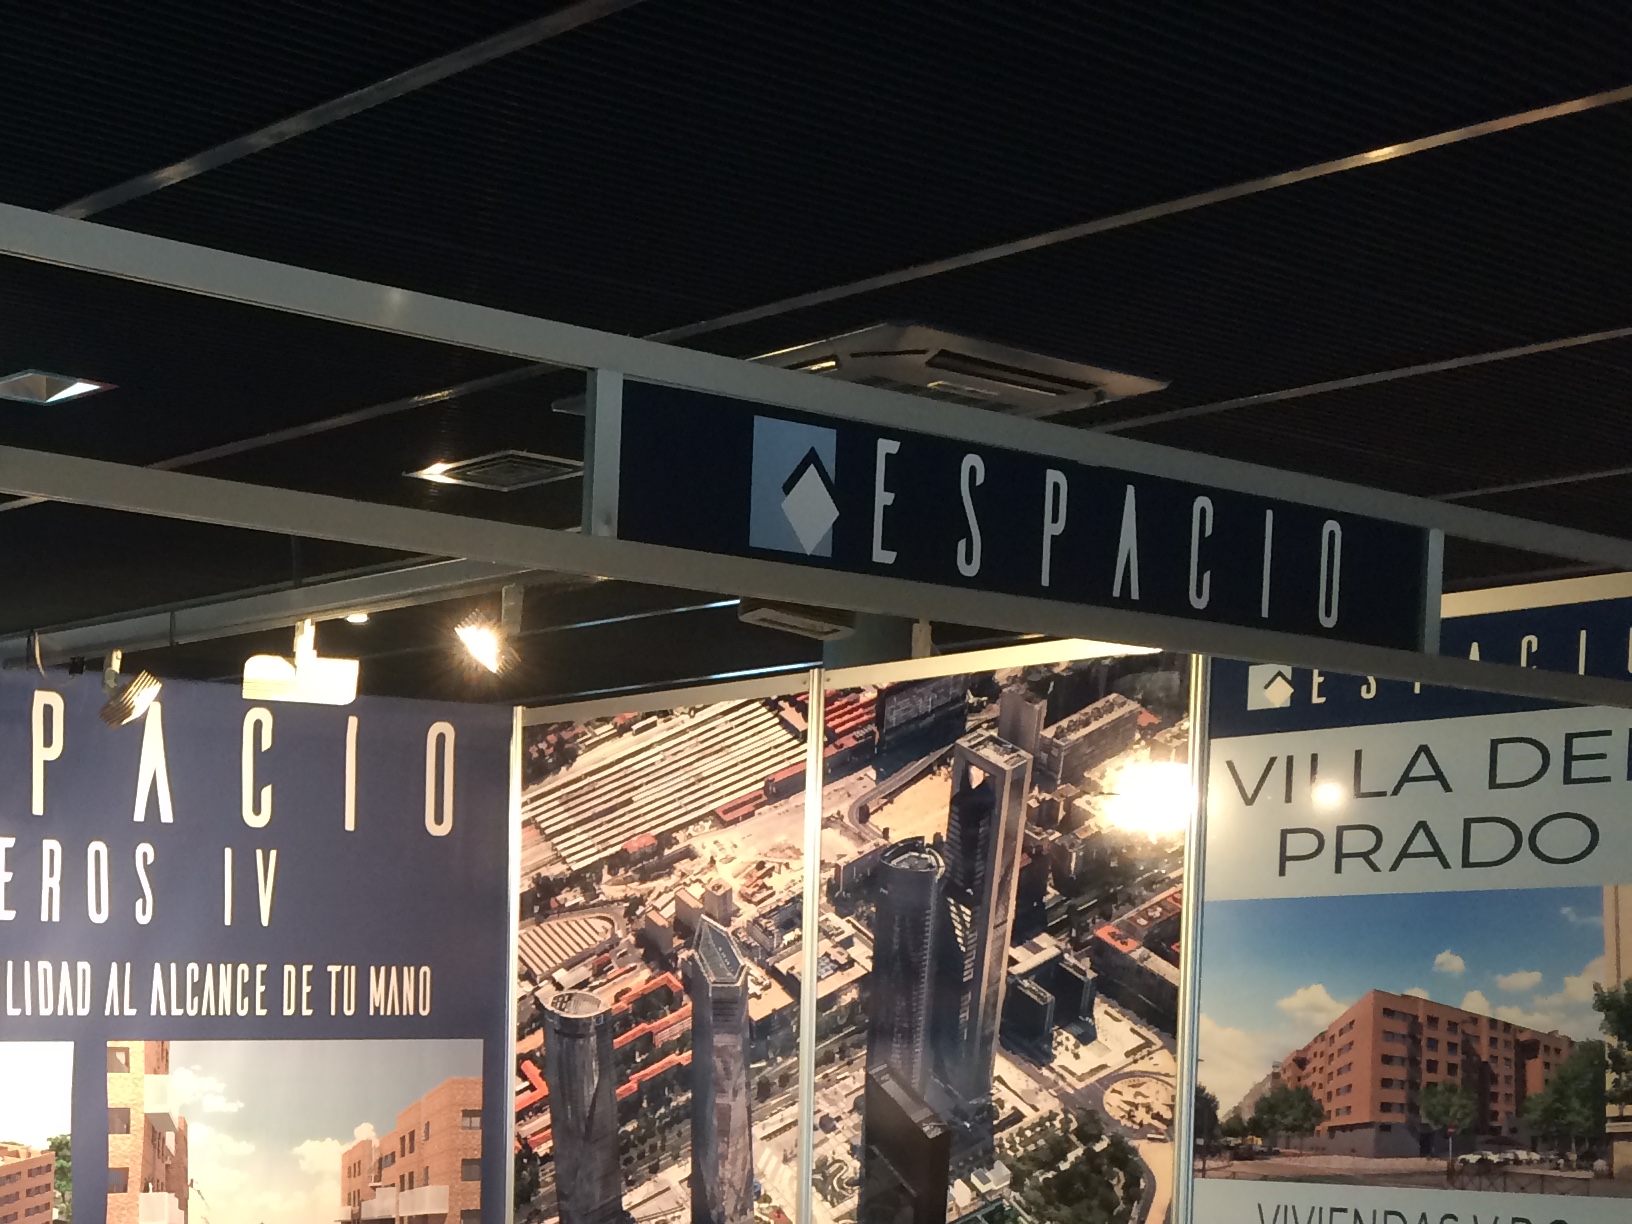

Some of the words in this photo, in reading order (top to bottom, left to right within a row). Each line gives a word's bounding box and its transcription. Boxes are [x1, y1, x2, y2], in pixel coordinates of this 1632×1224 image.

[871, 437, 1343, 628] ESPACIO
[1487, 729, 1632, 790] DE
[1277, 811, 1600, 877] PRADO
[224, 847, 277, 927] IV
[104, 961, 137, 1016] AL
[150, 962, 268, 1017] ALCANCE
[282, 964, 313, 1017] DE
[327, 965, 357, 1017] TU
[368, 965, 431, 1017] MANO
